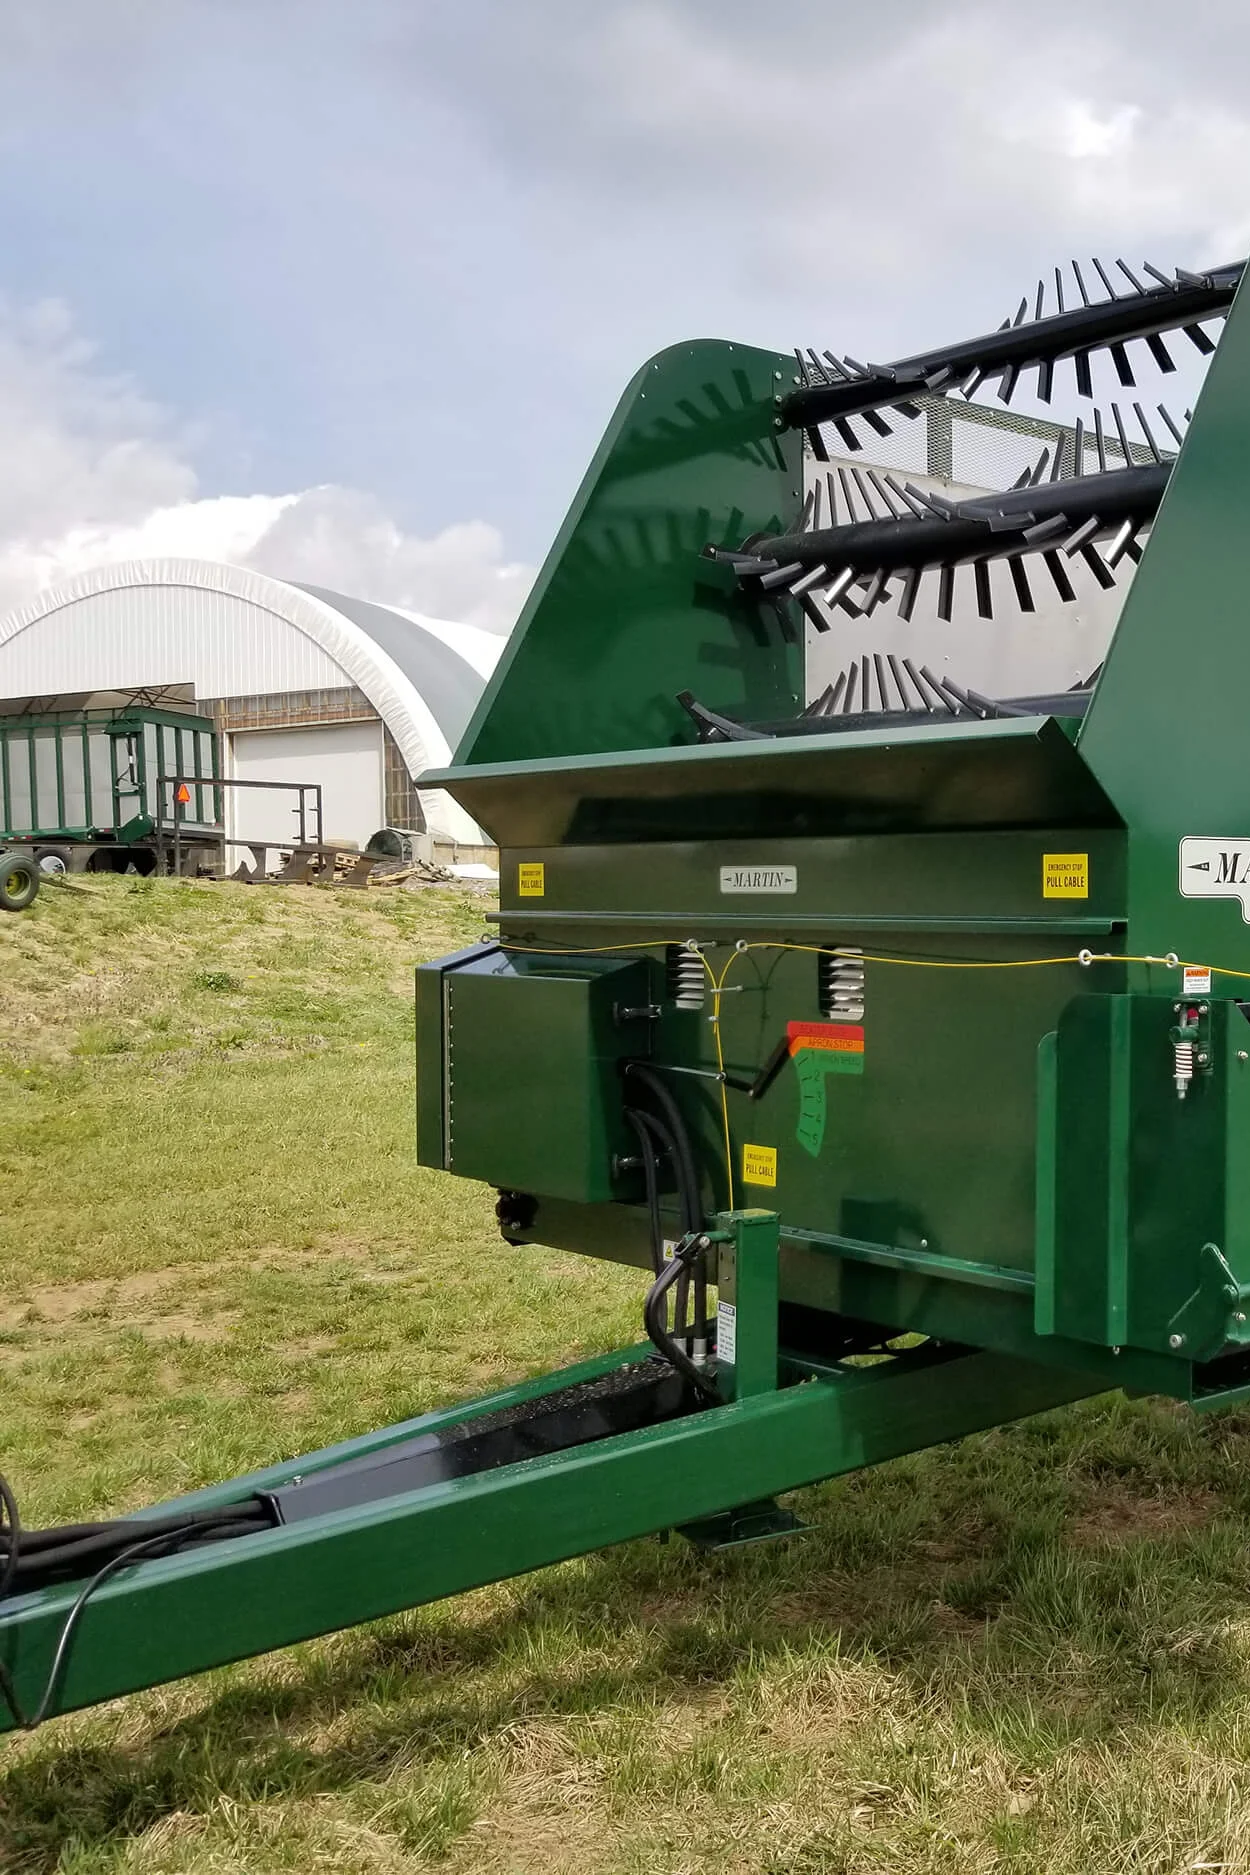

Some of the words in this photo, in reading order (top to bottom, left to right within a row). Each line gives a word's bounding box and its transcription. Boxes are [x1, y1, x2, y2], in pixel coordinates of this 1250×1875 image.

[733, 872, 784, 887] MARTIN
[1046, 876, 1062, 888] PULL
[1064, 876, 1084, 888] CABLE
[746, 1163, 758, 1175] PULL
[759, 1165, 774, 1177] CABLE
